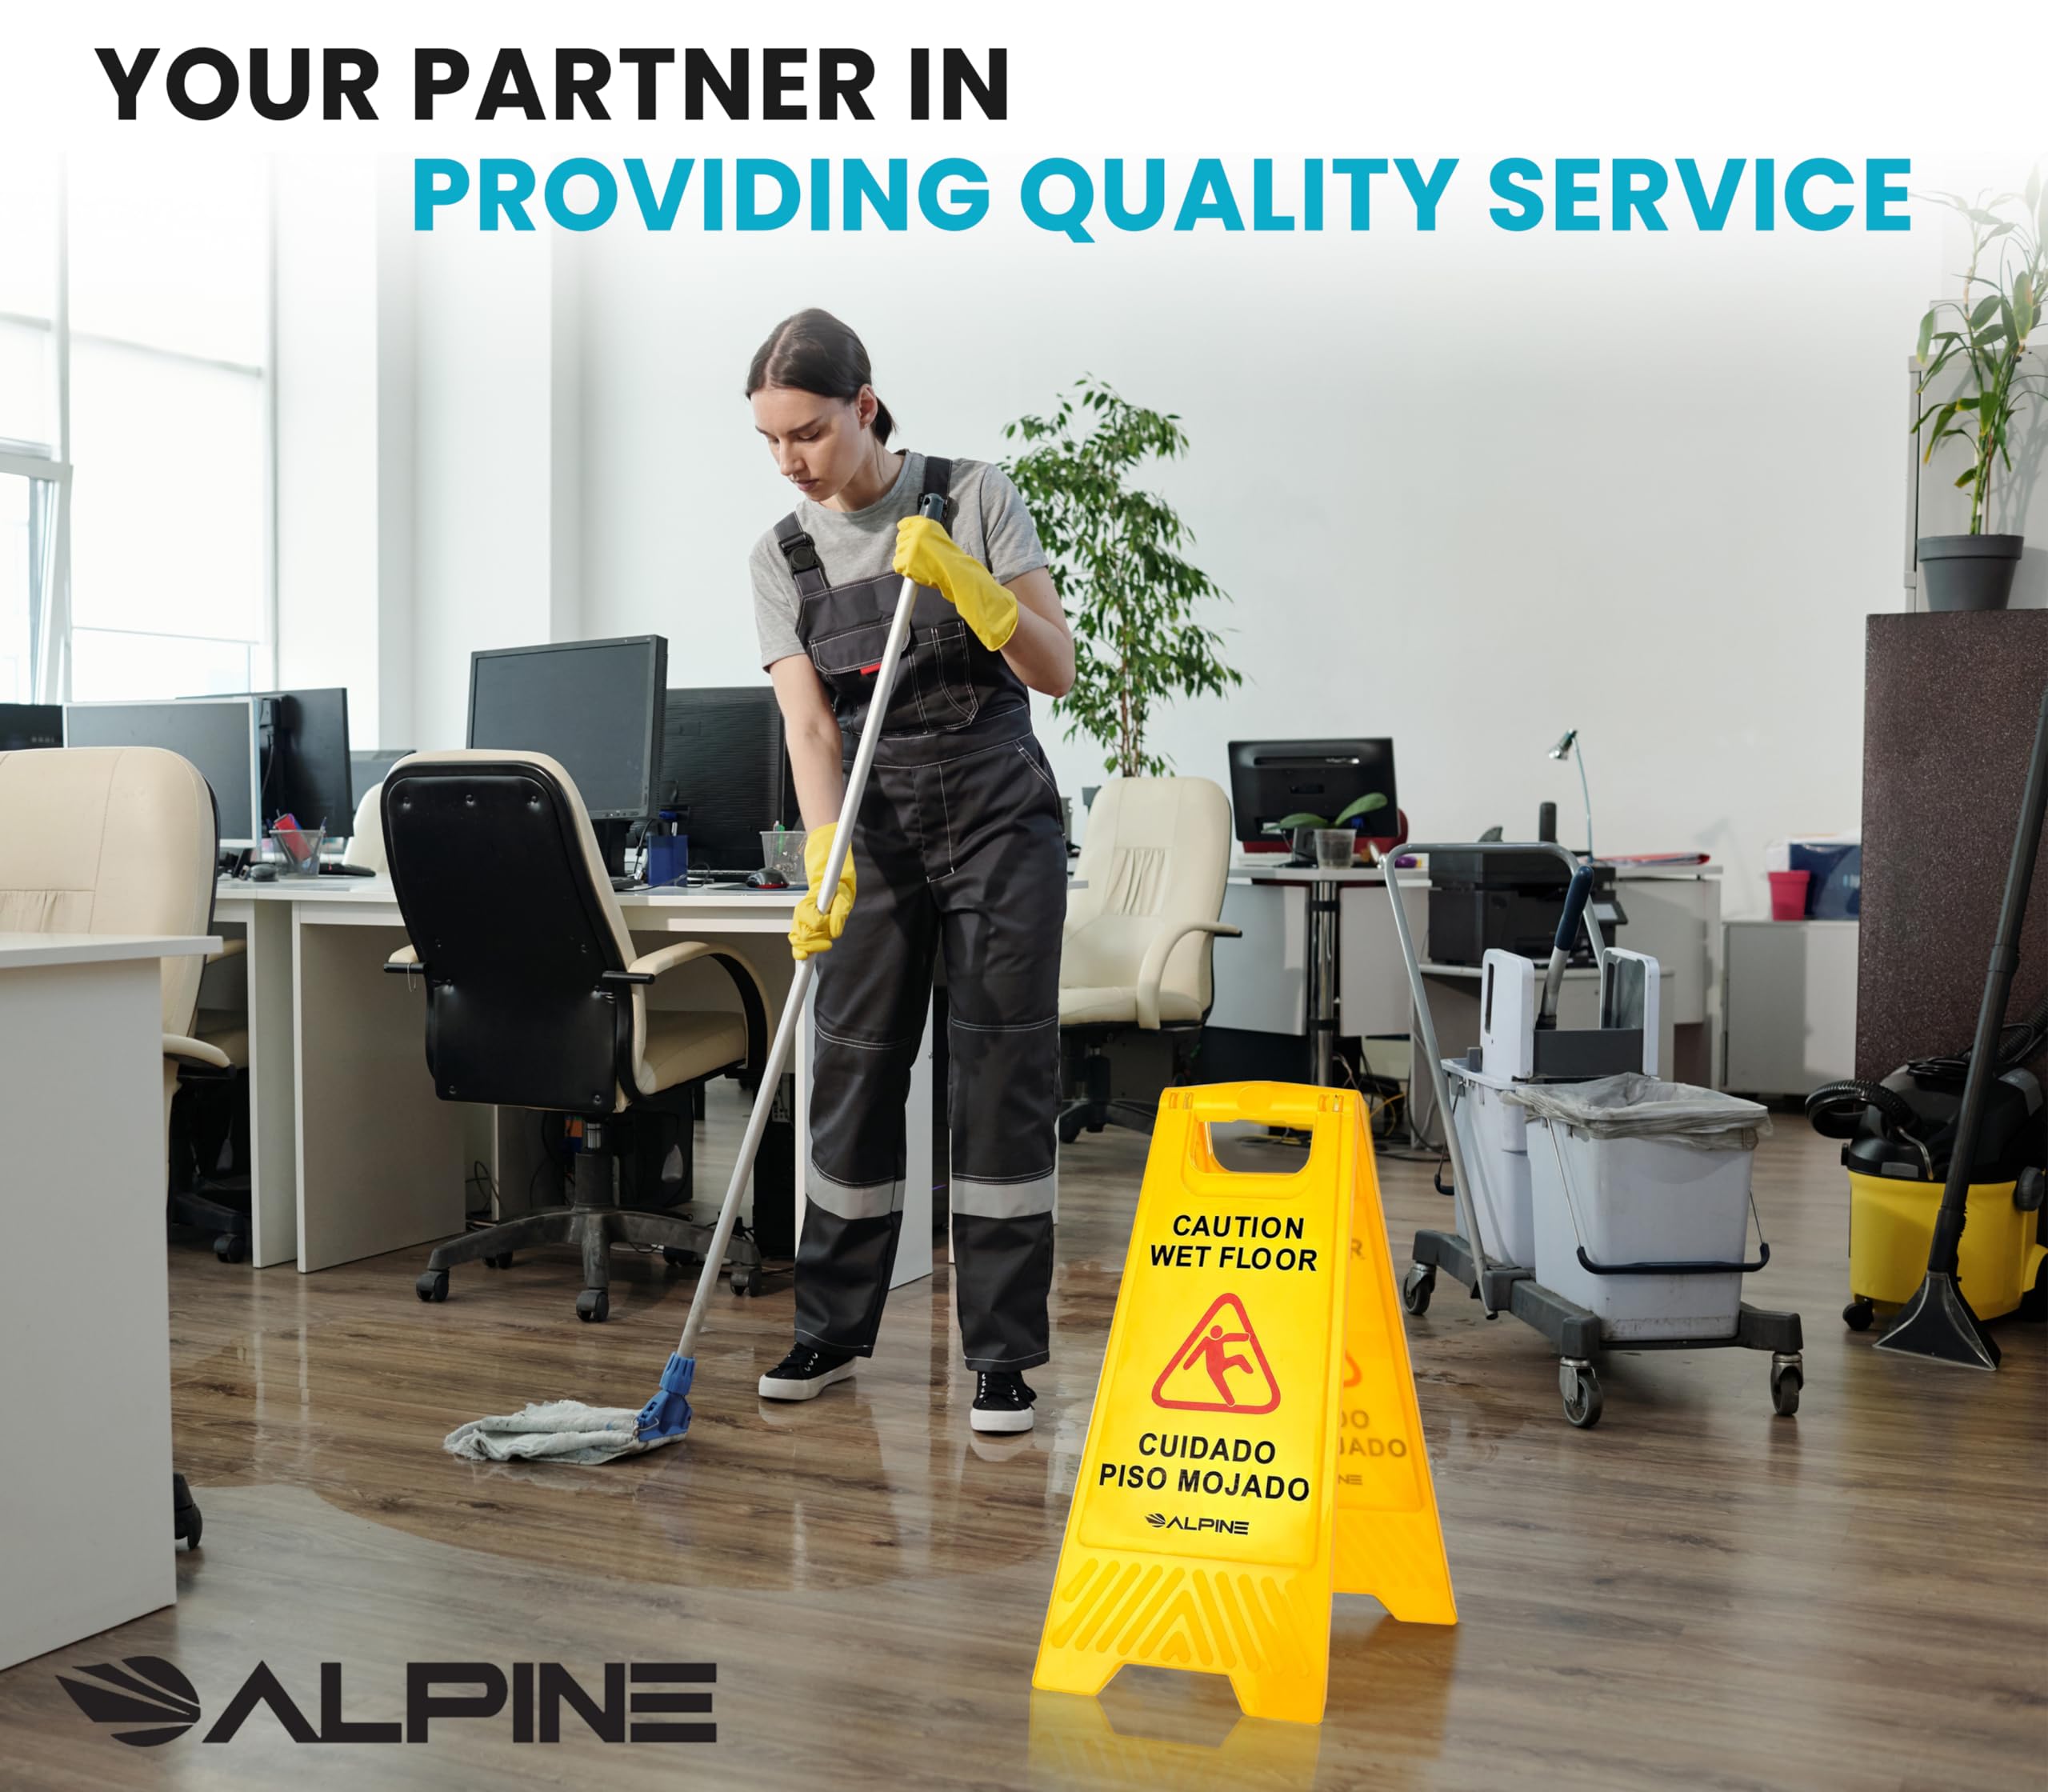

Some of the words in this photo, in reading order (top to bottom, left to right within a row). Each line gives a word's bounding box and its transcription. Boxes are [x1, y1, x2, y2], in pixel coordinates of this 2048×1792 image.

[1173, 1214, 1304, 1239] CAUTION
[1150, 1244, 1212, 1268] WET
[1219, 1246, 1318, 1272] FLOOR
[1138, 1433, 1276, 1465] CUIDADO
[1099, 1463, 1167, 1490] PISO
[1178, 1469, 1310, 1502] MOJADO
[1166, 1515, 1250, 1535] ALPINE
